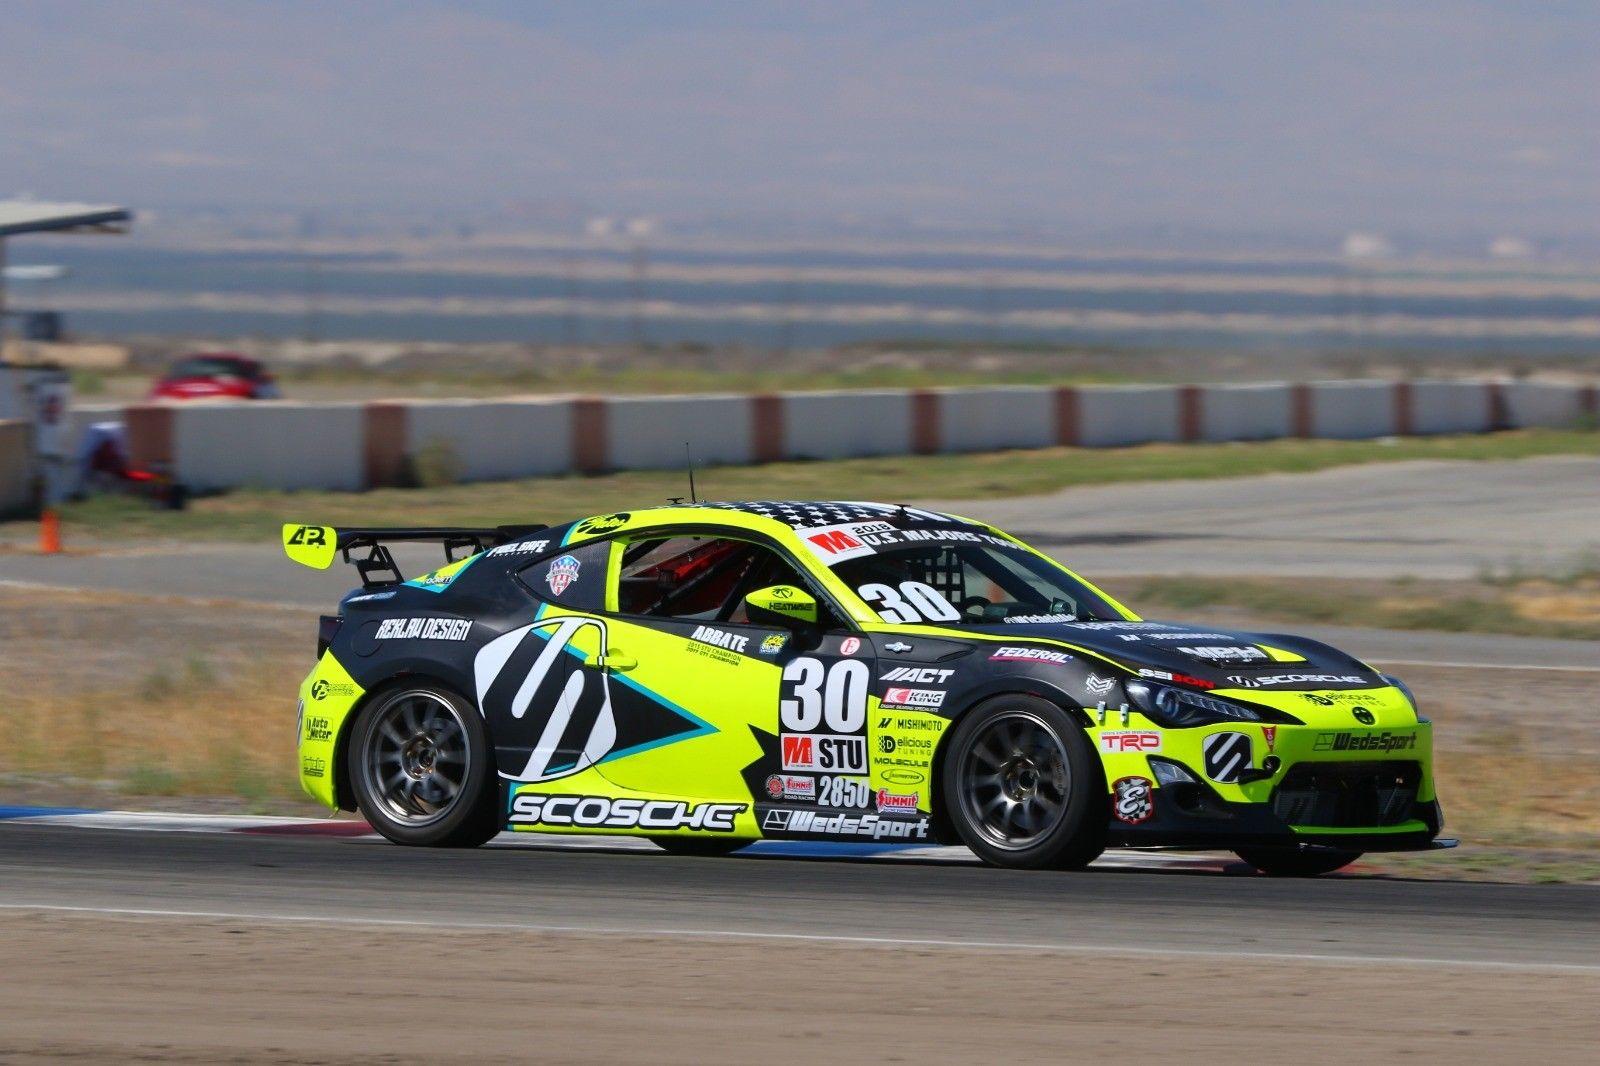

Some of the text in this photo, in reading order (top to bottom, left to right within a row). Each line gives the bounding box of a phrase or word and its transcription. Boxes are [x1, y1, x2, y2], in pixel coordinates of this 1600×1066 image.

[852, 523, 890, 534] 2018
[861, 532, 904, 545] U.S.
[900, 530, 982, 542] MAJORS
[858, 581, 962, 624] 30
[421, 618, 473, 640] DESIGN
[690, 625, 750, 653] ABBATE
[993, 646, 1070, 664] FEDERAL
[1257, 674, 1367, 685] SCOSCHE
[781, 657, 870, 733] 30
[909, 692, 942, 703] KING
[312, 718, 328, 728] Auto
[897, 718, 942, 731] MISHIMOTO
[310, 729, 332, 740] Meter
[1102, 735, 1160, 751] TRD
[1332, 732, 1416, 753] WedsSport
[818, 738, 863, 770] STU
[874, 757, 929, 767] MOLECULE
[818, 776, 870, 809] 2850
[508, 795, 742, 829] SCOSCHE
[787, 810, 930, 840] WedsSport
